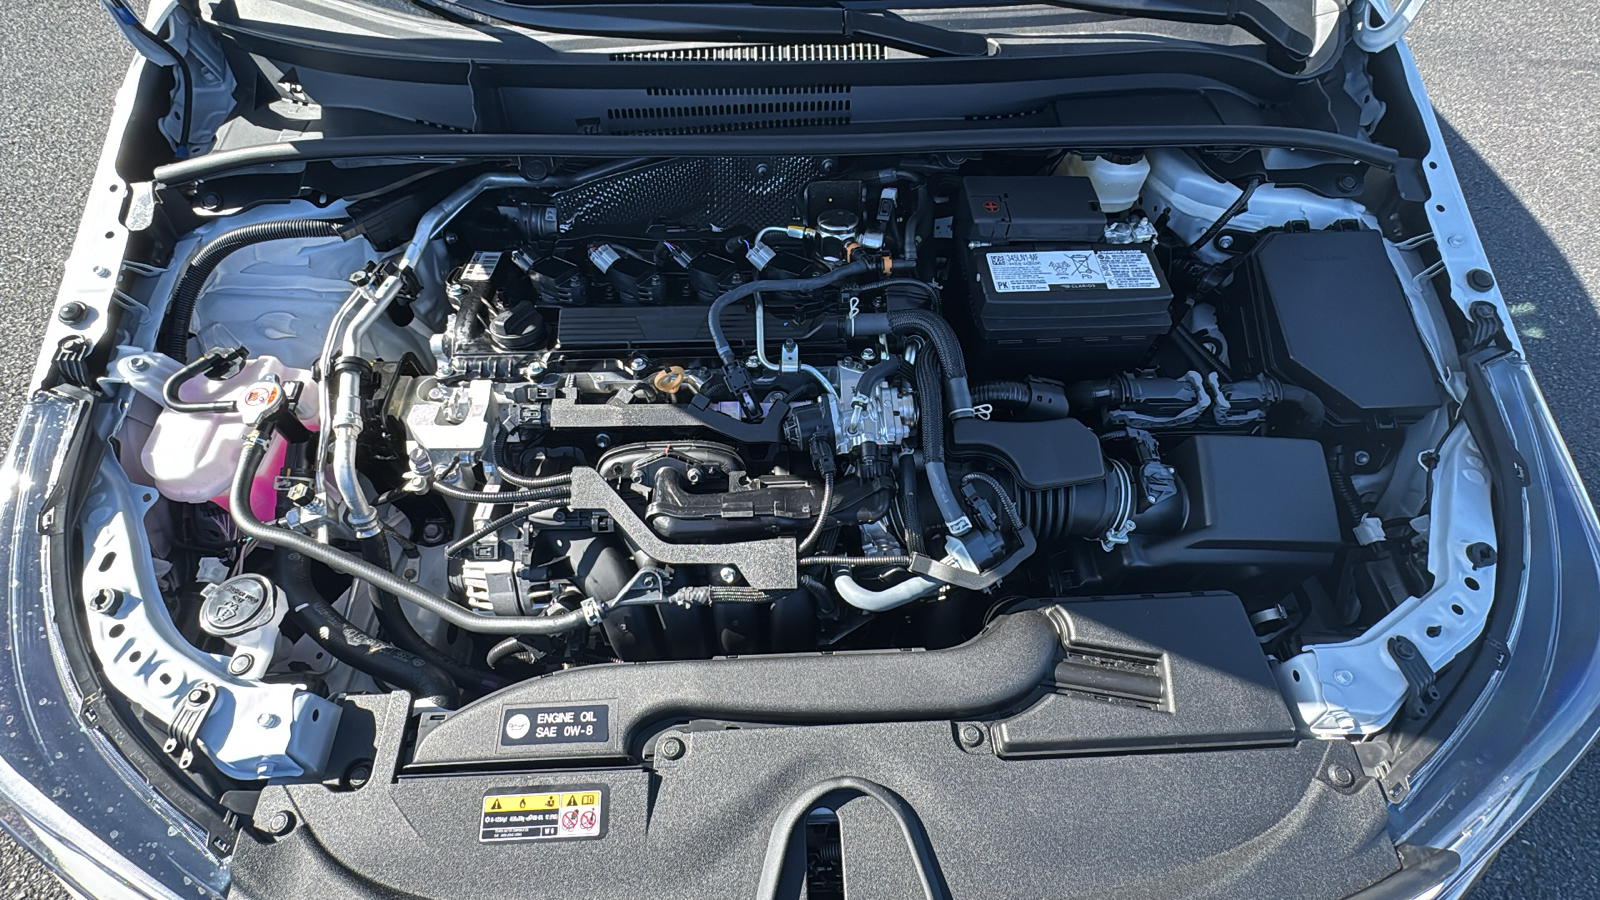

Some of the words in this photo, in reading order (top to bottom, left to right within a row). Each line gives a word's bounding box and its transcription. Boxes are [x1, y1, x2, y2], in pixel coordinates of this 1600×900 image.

[997, 281, 1009, 290] PK
[537, 712, 575, 724] ENGINE
[580, 711, 597, 722] OIL
[536, 726, 558, 738] SAE
